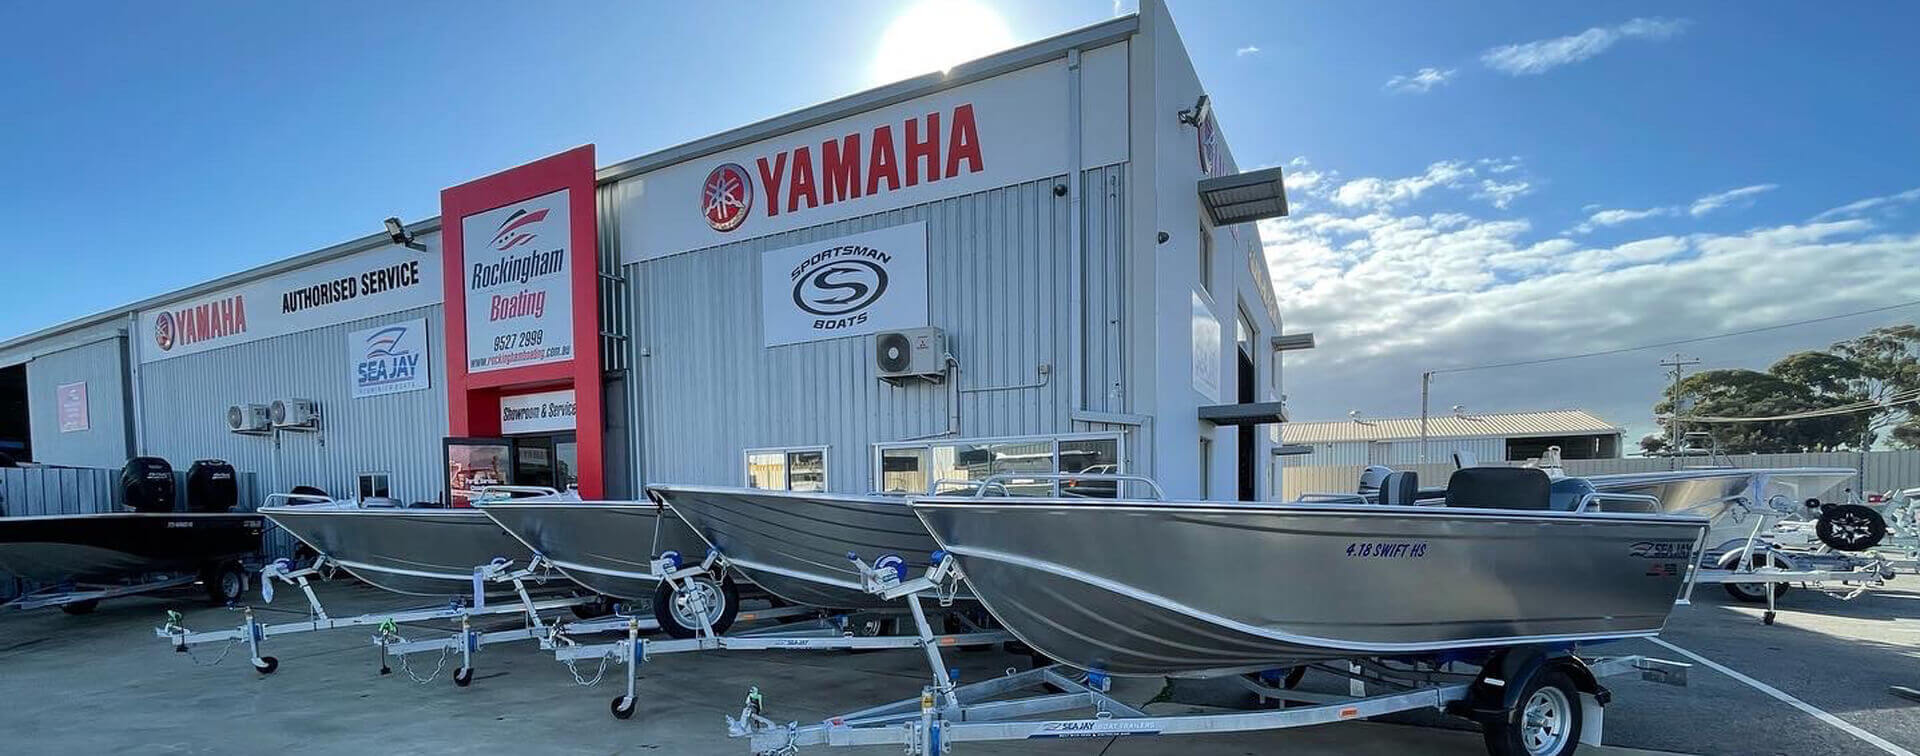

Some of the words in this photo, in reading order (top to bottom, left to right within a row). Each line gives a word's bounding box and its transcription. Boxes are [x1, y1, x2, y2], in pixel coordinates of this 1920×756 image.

[756, 103, 984, 217] YAMAHA
[471, 248, 564, 290] Rockingham
[791, 245, 892, 282] SPORTSMAN
[282, 276, 358, 314] AUTHORISED
[361, 260, 420, 296] SERVICE
[490, 288, 546, 322] Boating
[175, 295, 246, 346] YAMAHA
[813, 311, 868, 330] BOATS
[1346, 543, 1373, 557] 4.18
[1373, 543, 1410, 558] SWIFT
[1410, 543, 1427, 558] HS
